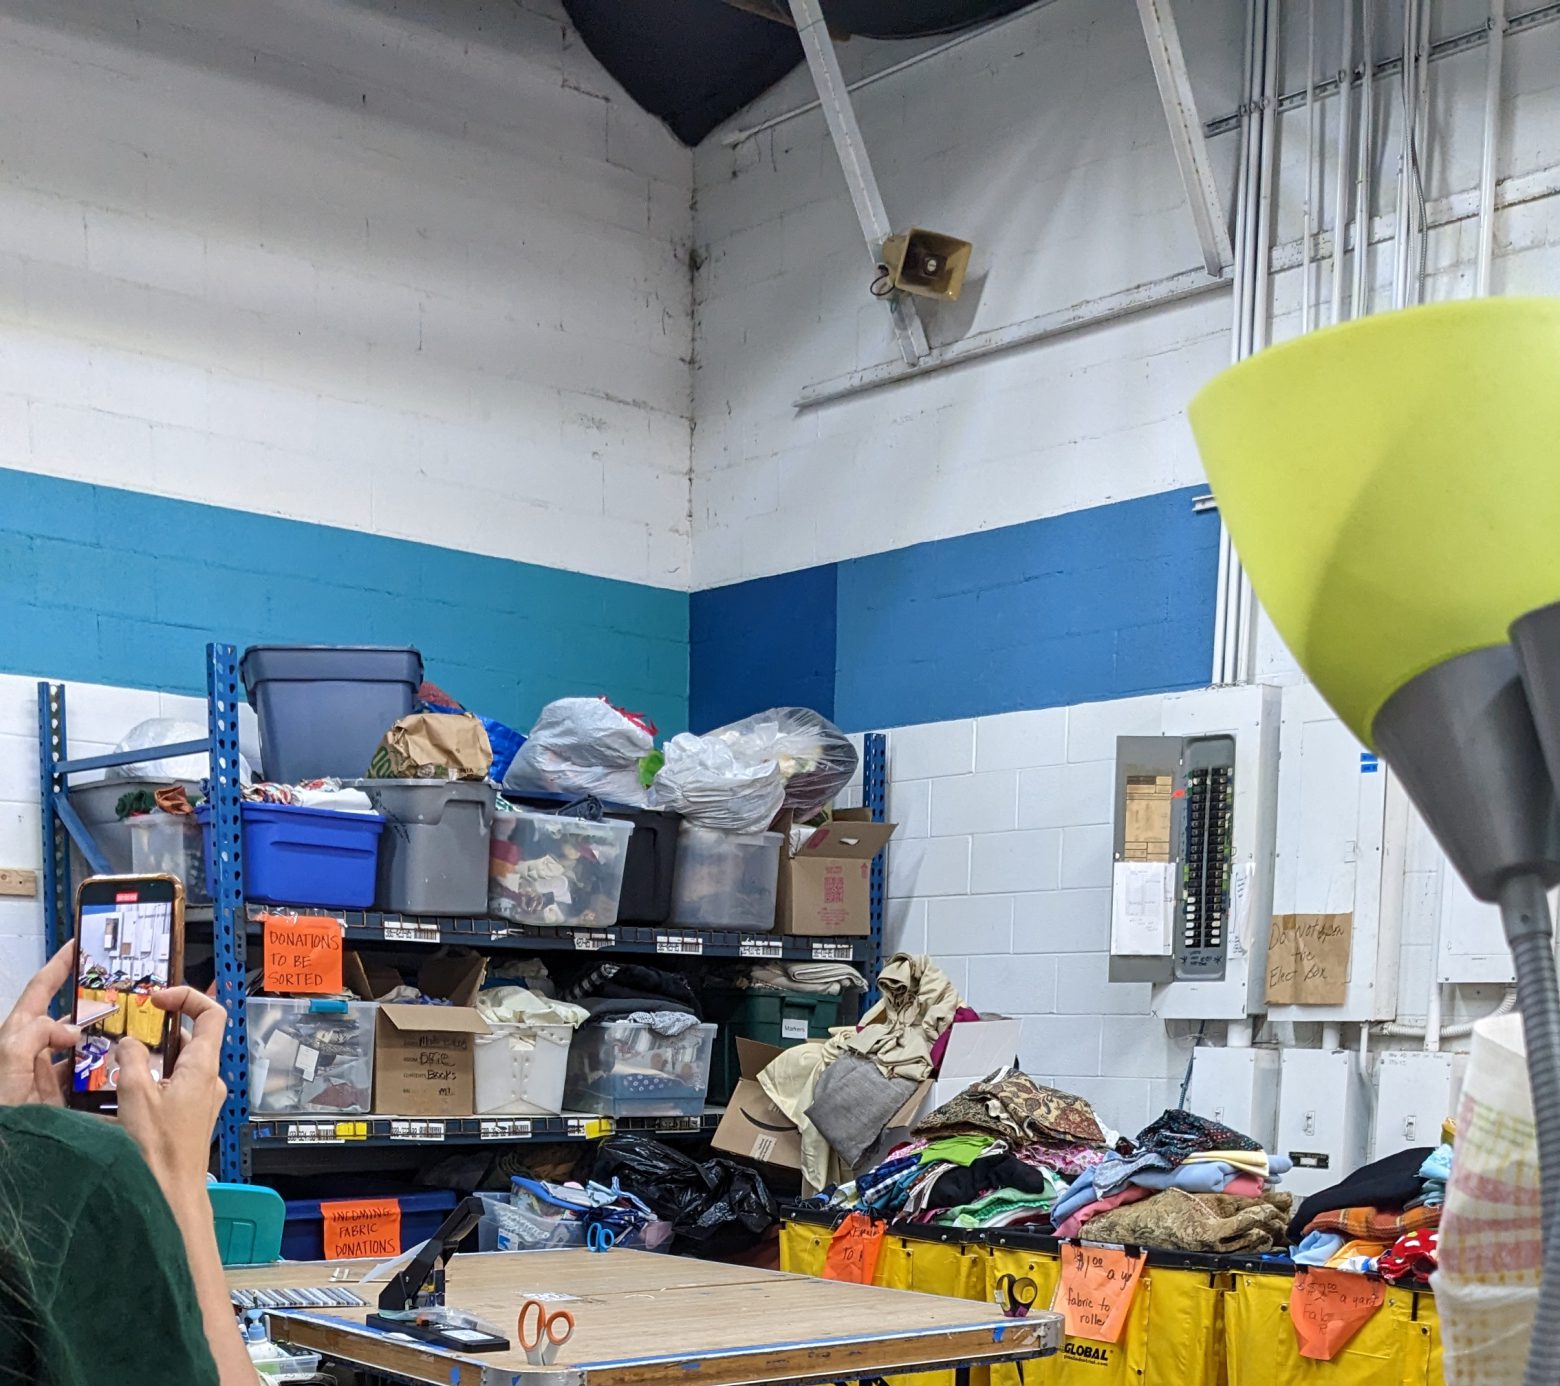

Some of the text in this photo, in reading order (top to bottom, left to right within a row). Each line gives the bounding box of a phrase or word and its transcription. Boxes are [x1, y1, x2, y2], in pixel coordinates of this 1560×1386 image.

[269, 930, 340, 951] DONATIONS
[270, 952, 312, 968] TO BE
[268, 971, 323, 986] SORTED
[332, 1207, 394, 1222] INCOMING
[340, 1222, 378, 1239] FABRIC
[335, 1238, 396, 1257] DONATIONS
[1107, 1269, 1116, 1280] a
[1067, 1287, 1111, 1312] fabric to
[1340, 1294, 1347, 1304] a
[1064, 1343, 1109, 1361] GLOBAL
